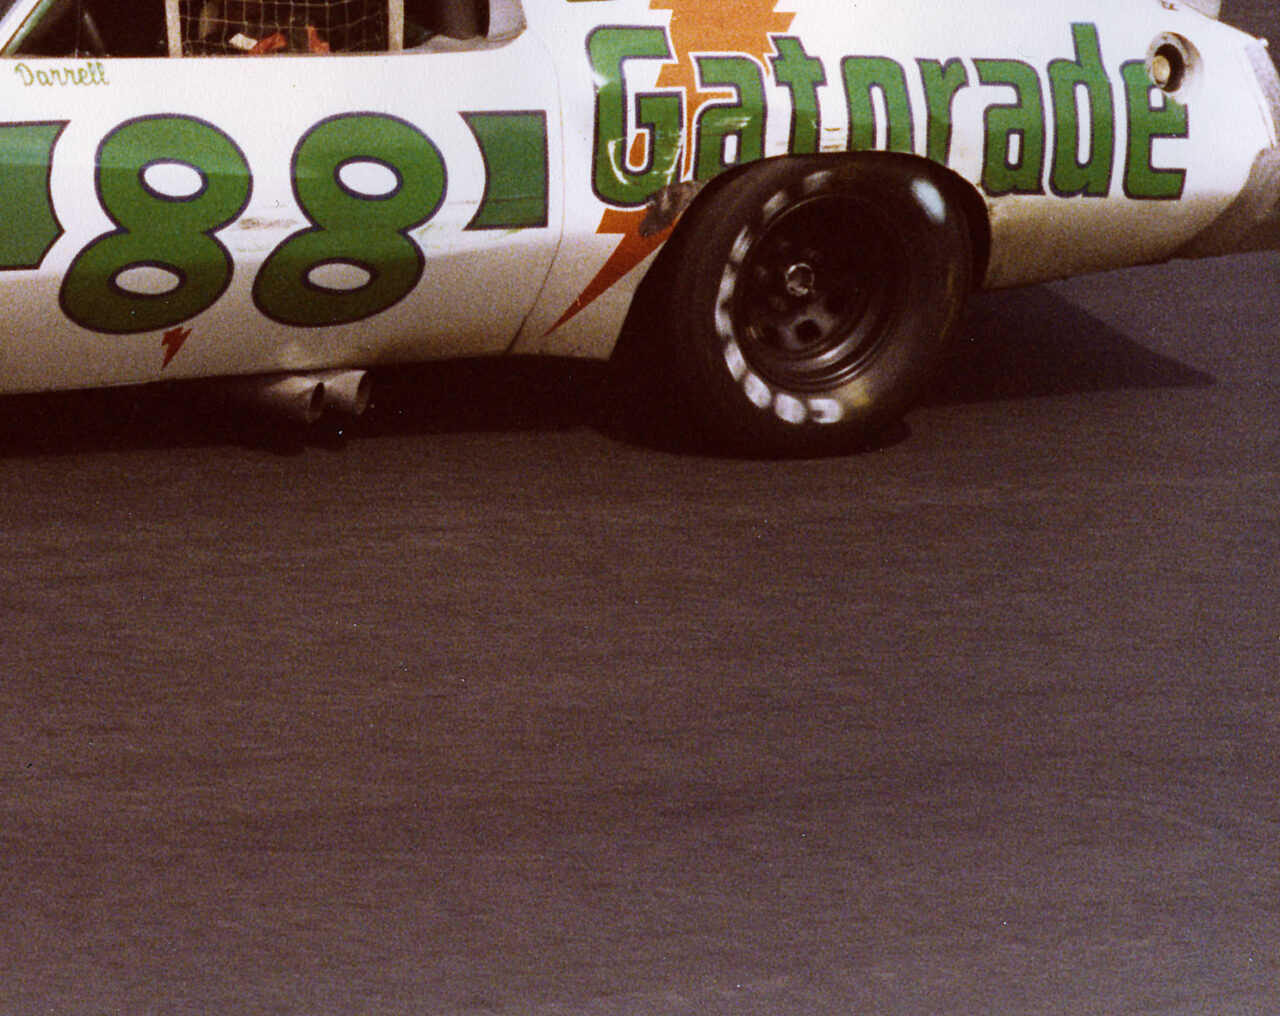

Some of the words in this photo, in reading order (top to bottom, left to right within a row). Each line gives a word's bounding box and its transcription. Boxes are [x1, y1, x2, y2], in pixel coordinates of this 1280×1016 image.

[14, 62, 109, 86] Darrell
[584, 21, 1188, 209] Gatorade
[58, 111, 448, 335] 88
